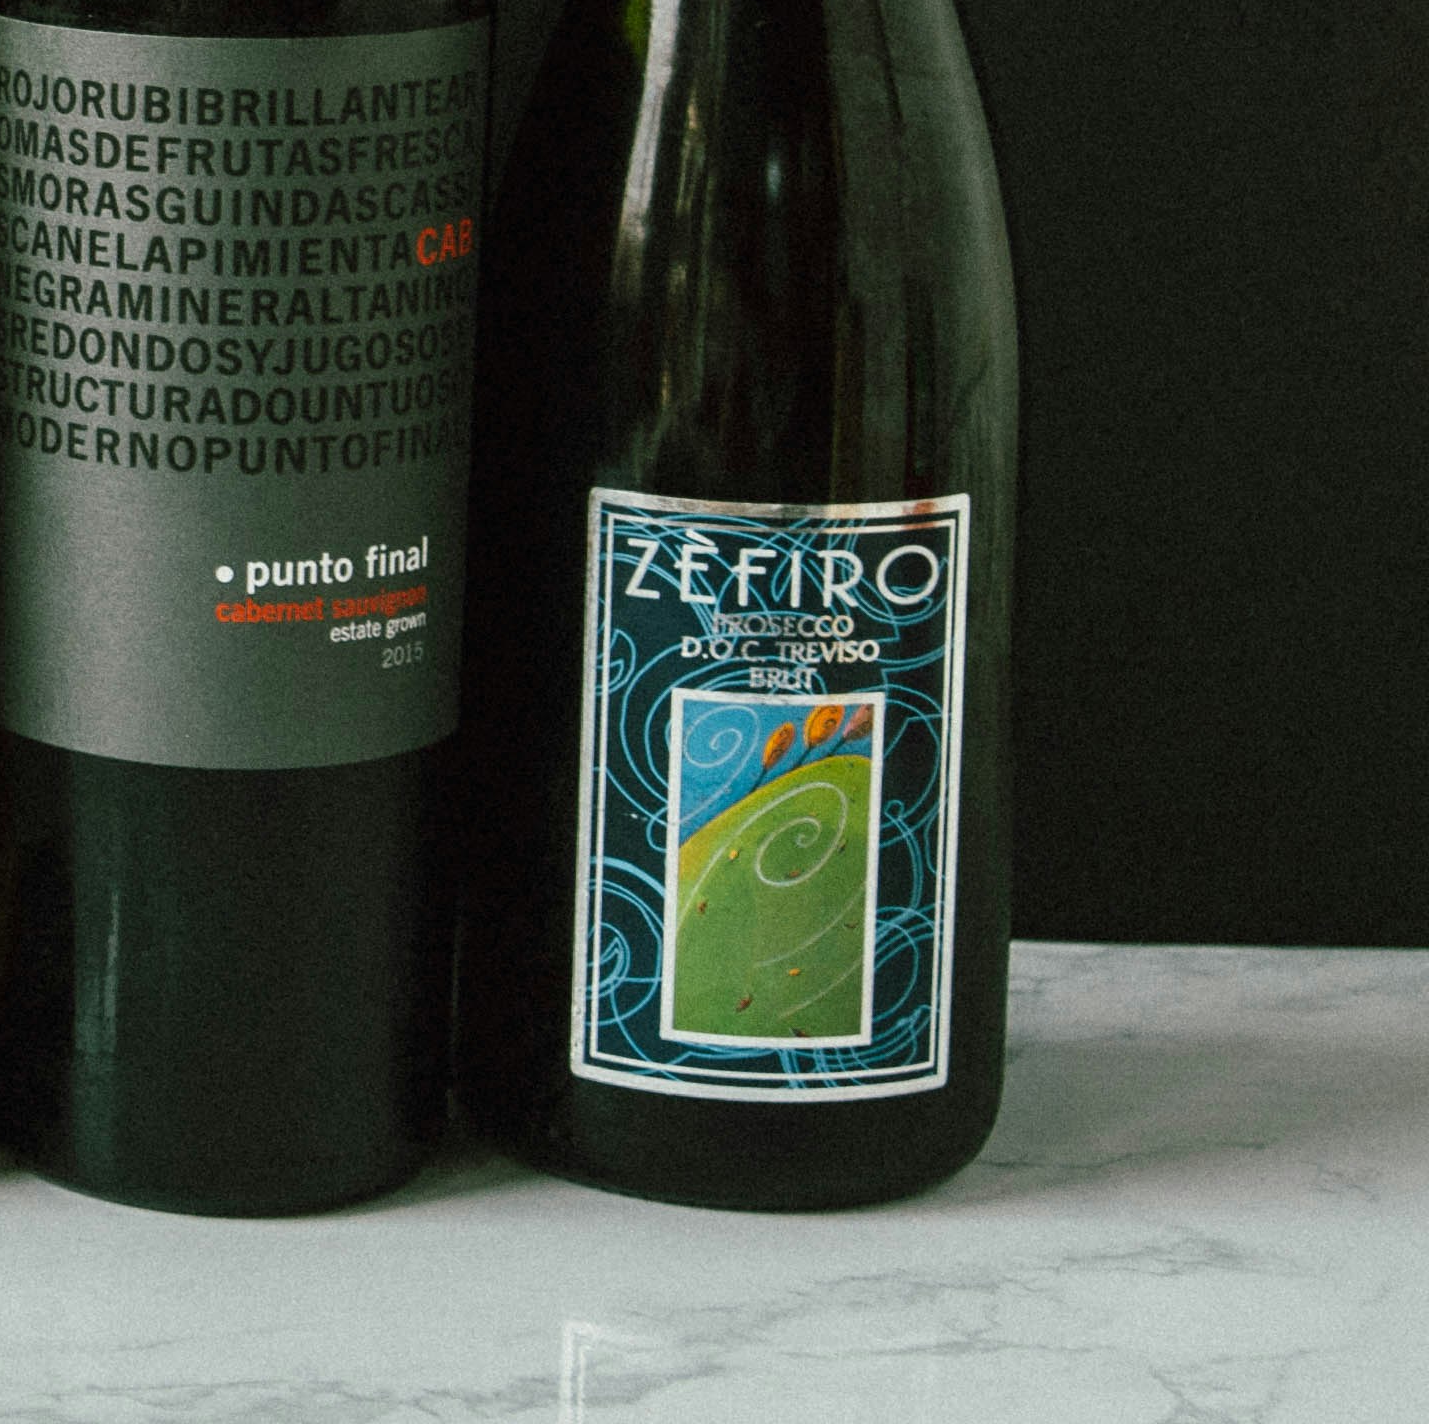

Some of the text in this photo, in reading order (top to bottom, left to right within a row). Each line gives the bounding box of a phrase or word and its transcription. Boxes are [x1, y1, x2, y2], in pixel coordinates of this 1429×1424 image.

[246, 535, 429, 595] punto final
[624, 528, 940, 609] ZÈFIRO
[215, 583, 428, 623] cabernet sauvignon
[329, 611, 427, 643] estate grown
[713, 612, 855, 638] PROSECCO
[382, 641, 424, 669] 2015
[774, 639, 880, 664] TREVISO
[749, 666, 818, 690] BRUT
